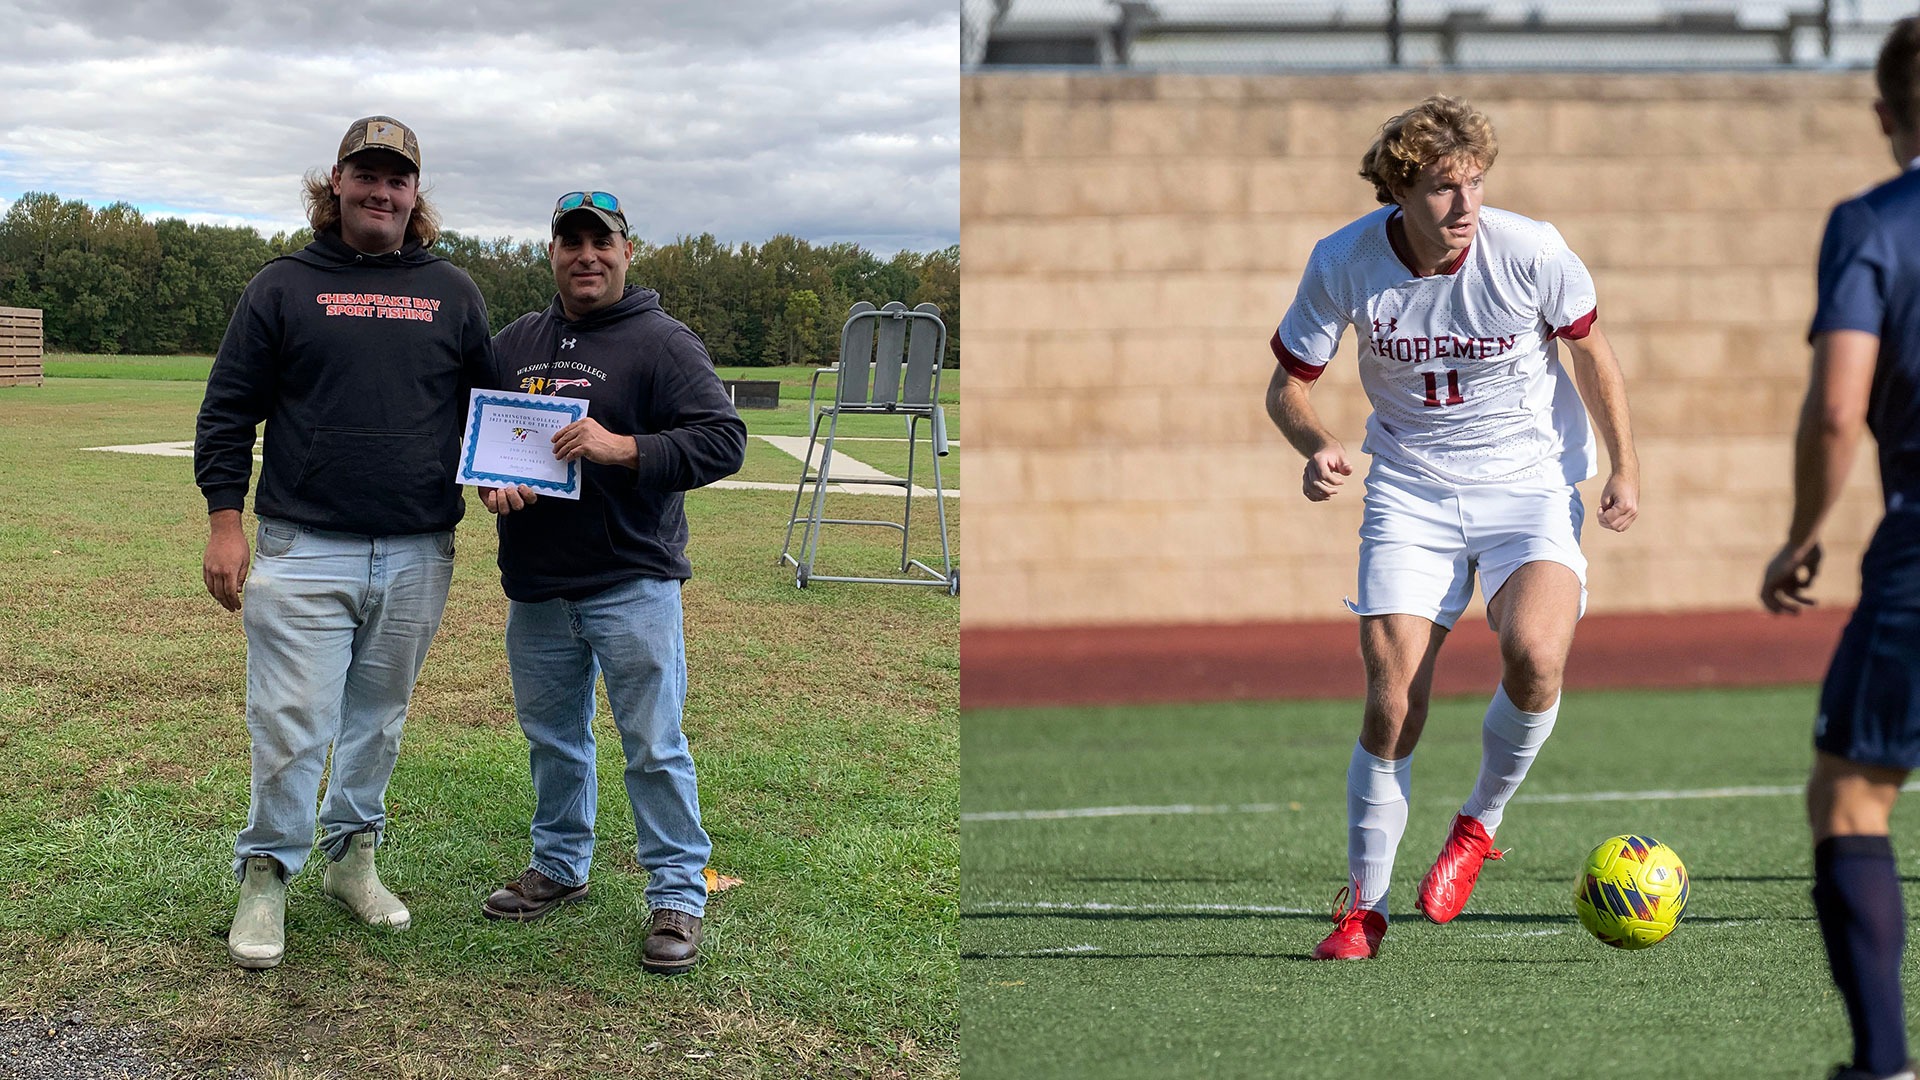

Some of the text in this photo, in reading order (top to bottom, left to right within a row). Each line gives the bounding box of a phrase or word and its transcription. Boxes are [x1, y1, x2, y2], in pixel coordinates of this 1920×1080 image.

[317, 293, 441, 311] CHESAPEAKE BAY
[326, 304, 433, 322] SPORT FISHING
[517, 361, 608, 381] WASHINTON COLLEGE
[1421, 369, 1464, 407] 11
[493, 412, 531, 421] WASHINGTON
